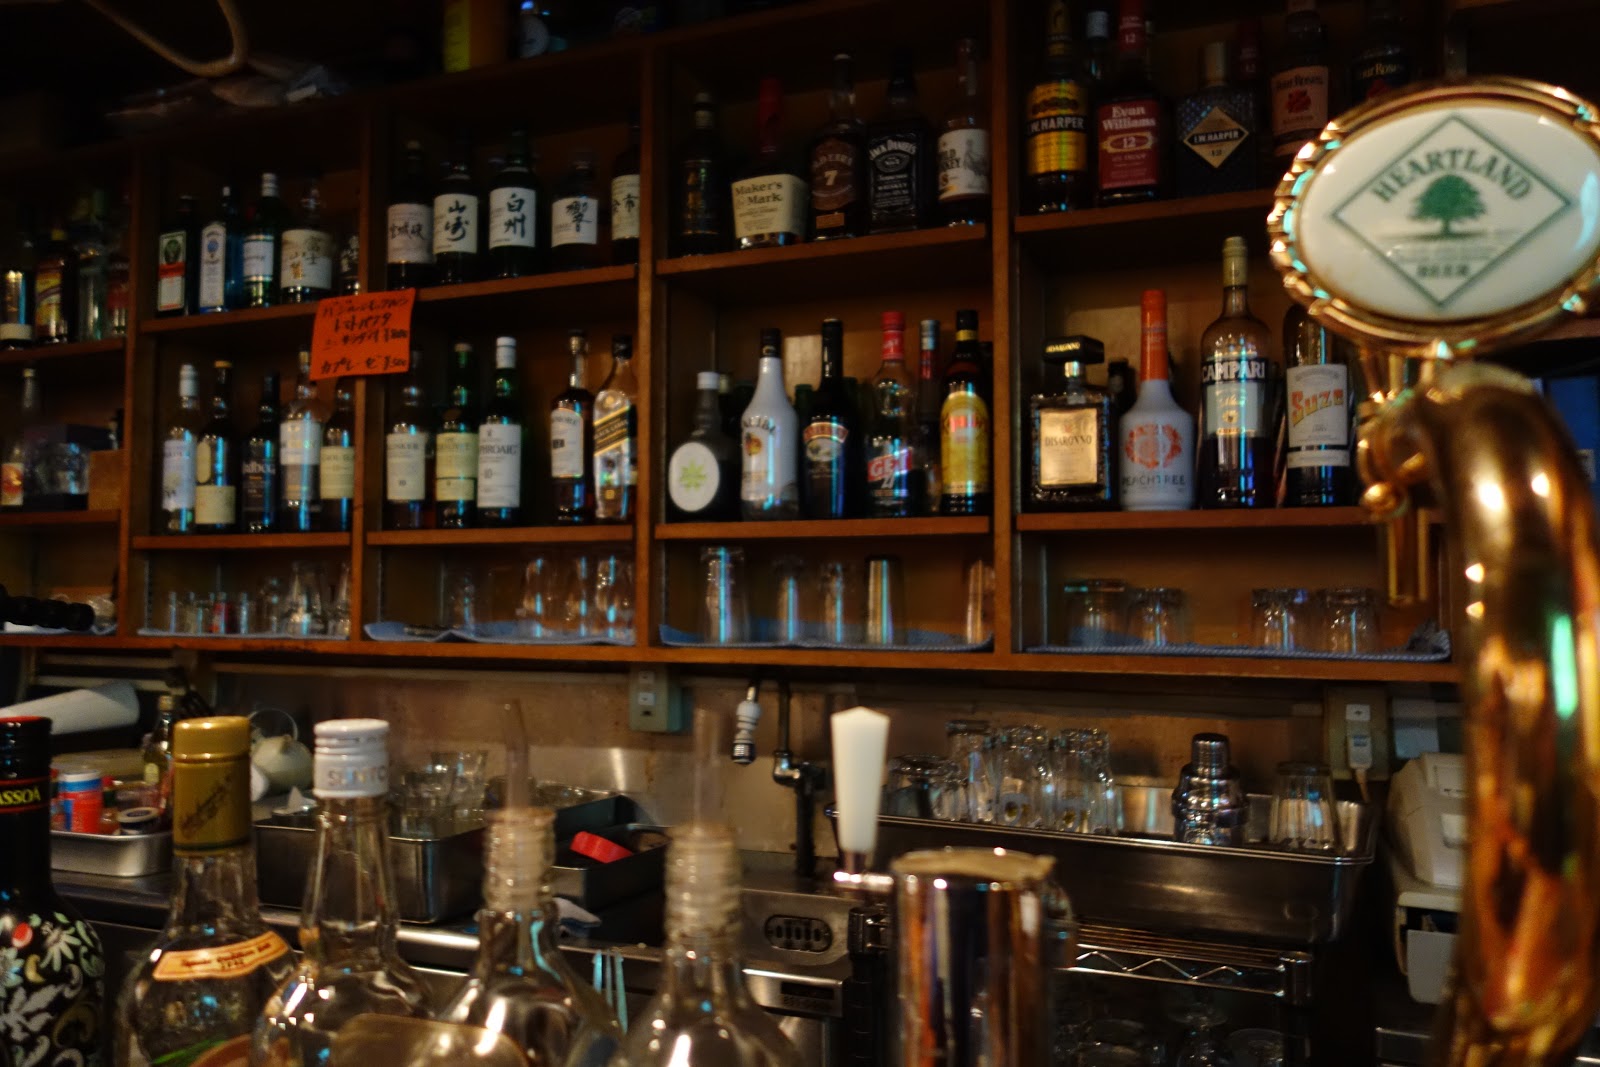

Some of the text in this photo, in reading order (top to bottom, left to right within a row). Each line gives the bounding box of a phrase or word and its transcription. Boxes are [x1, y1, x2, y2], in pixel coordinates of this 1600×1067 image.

[1112, 106, 1146, 118] Evan
[1102, 117, 1157, 131] Williams
[1123, 136, 1136, 149] 12
[824, 170, 839, 186] 7
[1371, 148, 1533, 203] HEARTLAND
[735, 181, 783, 195] Maker's
[746, 192, 783, 205] Mark
[503, 193, 526, 239] 白州
[1201, 360, 1266, 383] CAMPARI
[1291, 388, 1344, 427] Suze
[1045, 435, 1093, 448] DISARONNO
[1121, 475, 1186, 488] PEACHTREE
